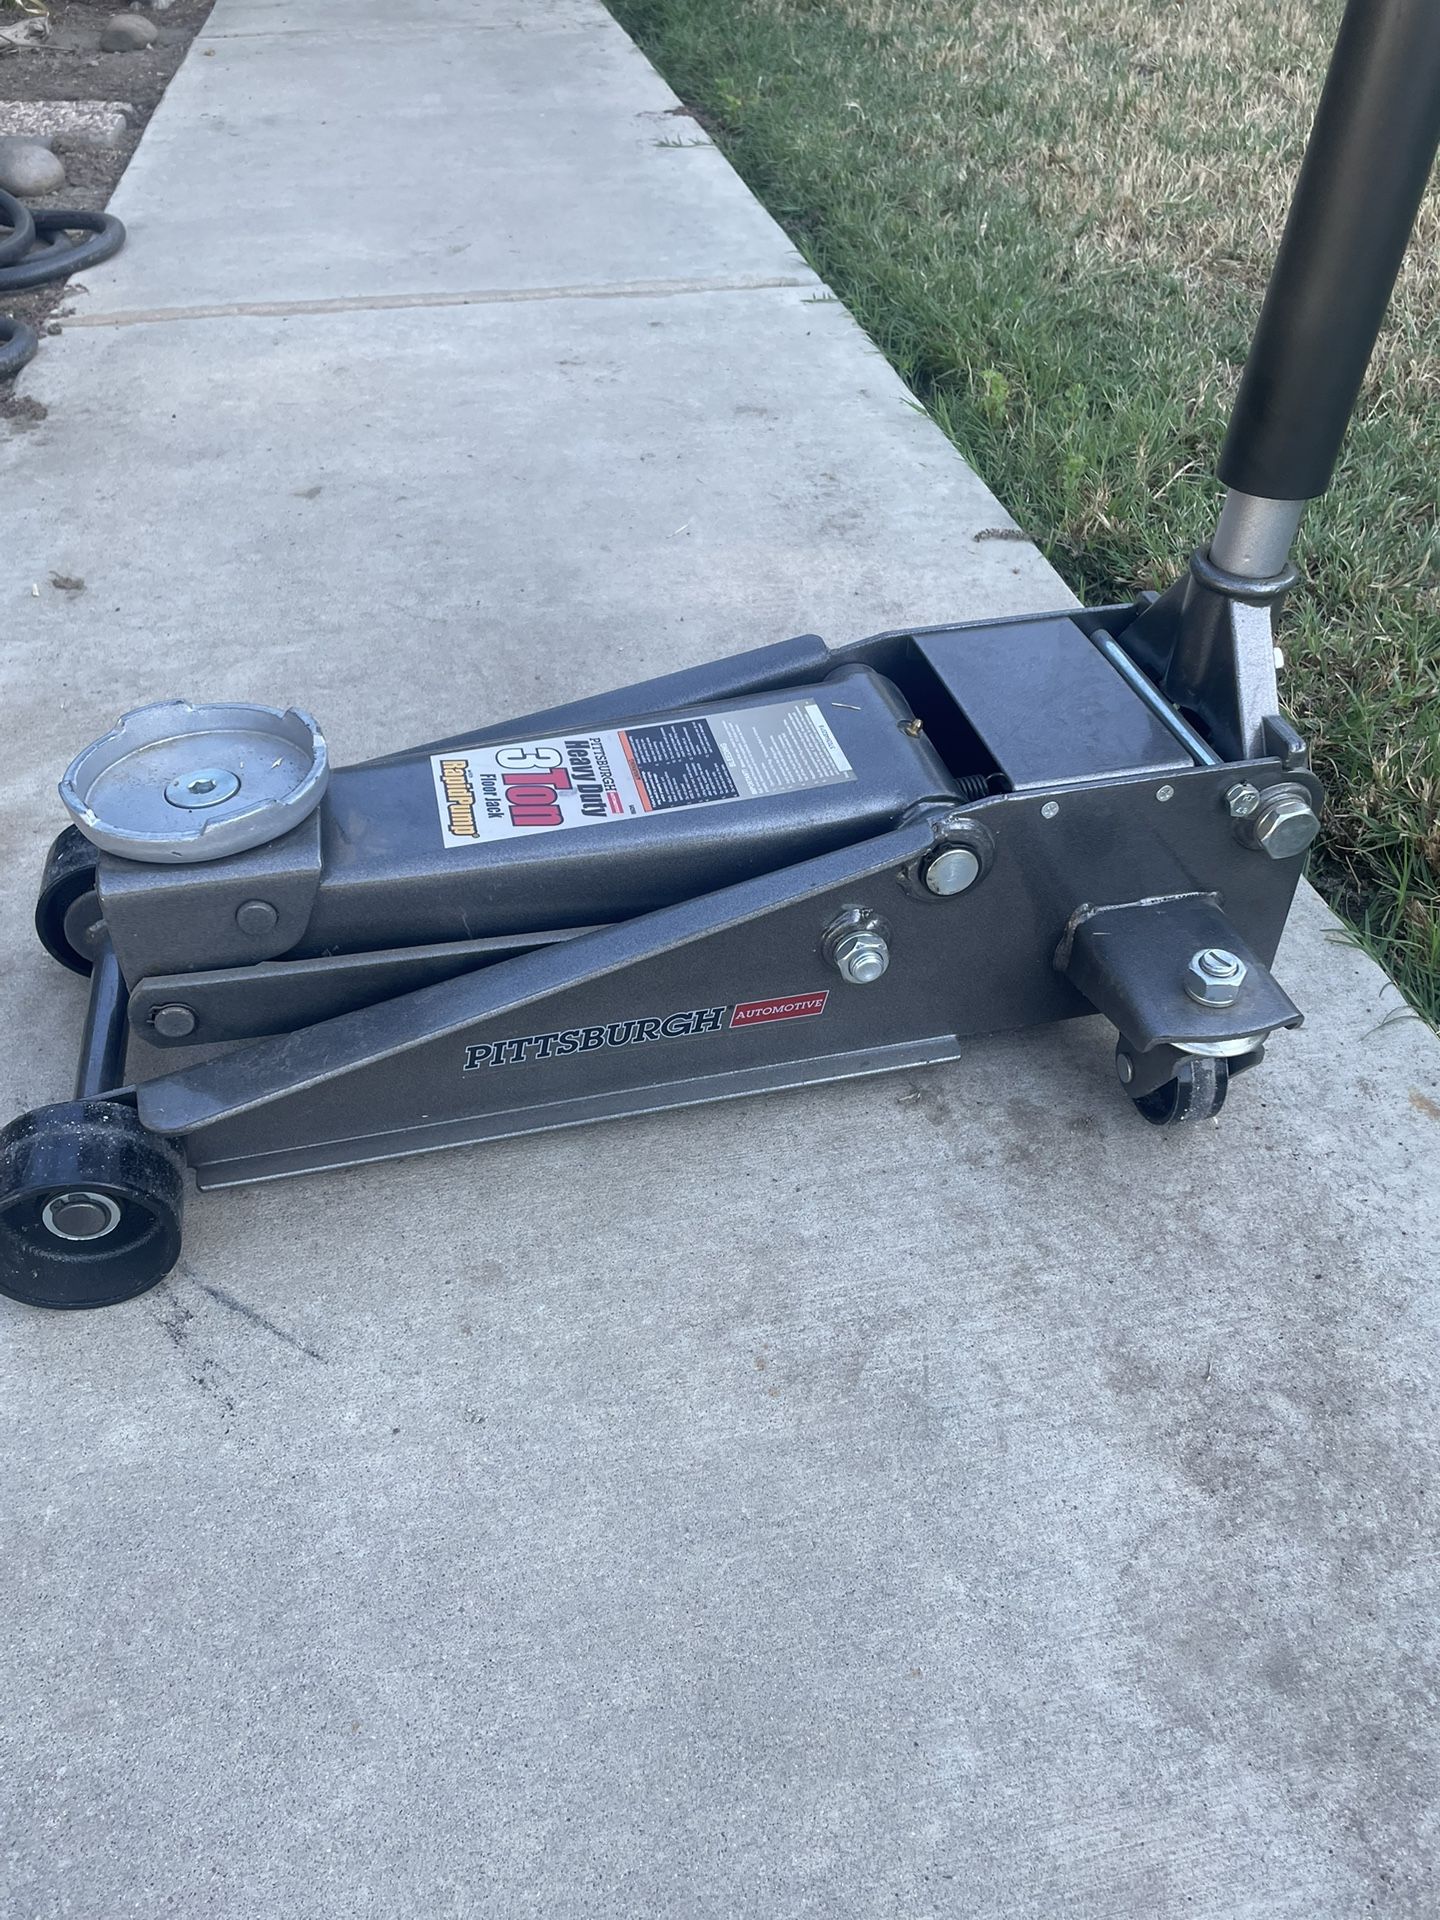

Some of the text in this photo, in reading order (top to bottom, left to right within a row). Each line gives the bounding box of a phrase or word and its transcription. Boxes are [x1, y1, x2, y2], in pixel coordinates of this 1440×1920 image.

[479, 773, 505, 819] Floor Jack
[495, 748, 574, 827] 3 Ton
[564, 740, 608, 817] Heavy Duty
[589, 737, 618, 792] PITTSBURGH
[463, 998, 824, 1072] PITTSBURGH AUTOMOTIVE
